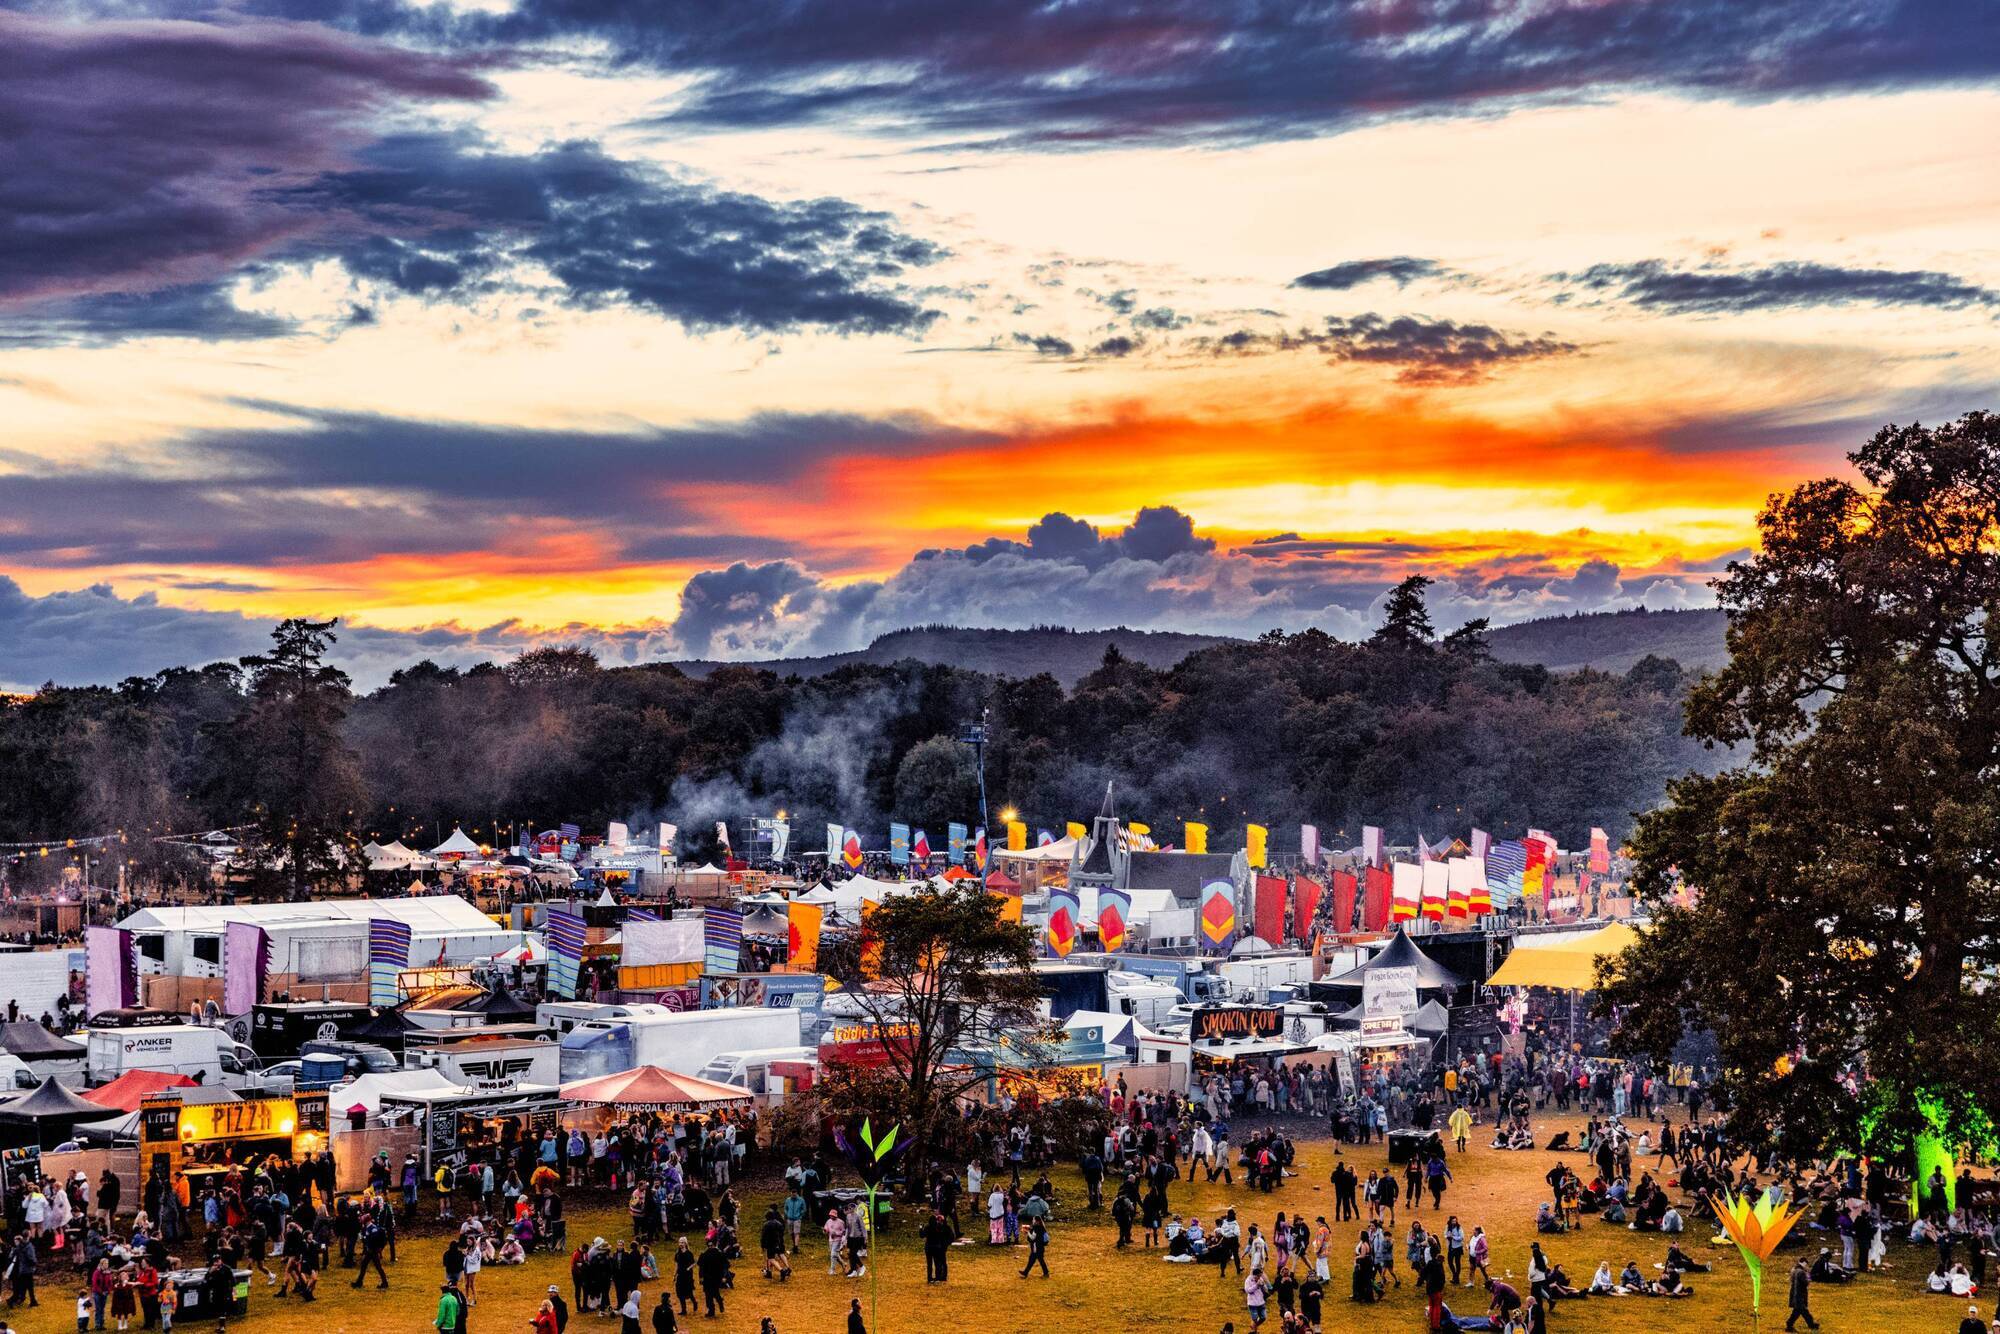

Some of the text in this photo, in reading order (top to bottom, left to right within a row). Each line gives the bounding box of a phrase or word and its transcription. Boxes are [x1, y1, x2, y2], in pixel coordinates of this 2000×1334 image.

[1251, 1010, 1278, 1032] COW
[834, 1024, 868, 1041] Eddie
[137, 1038, 172, 1046] ANKER
[478, 1079, 514, 1089] WING BAR
[614, 1102, 691, 1112] CHARCOAL GRILL
[211, 1103, 273, 1133] PIZZA
